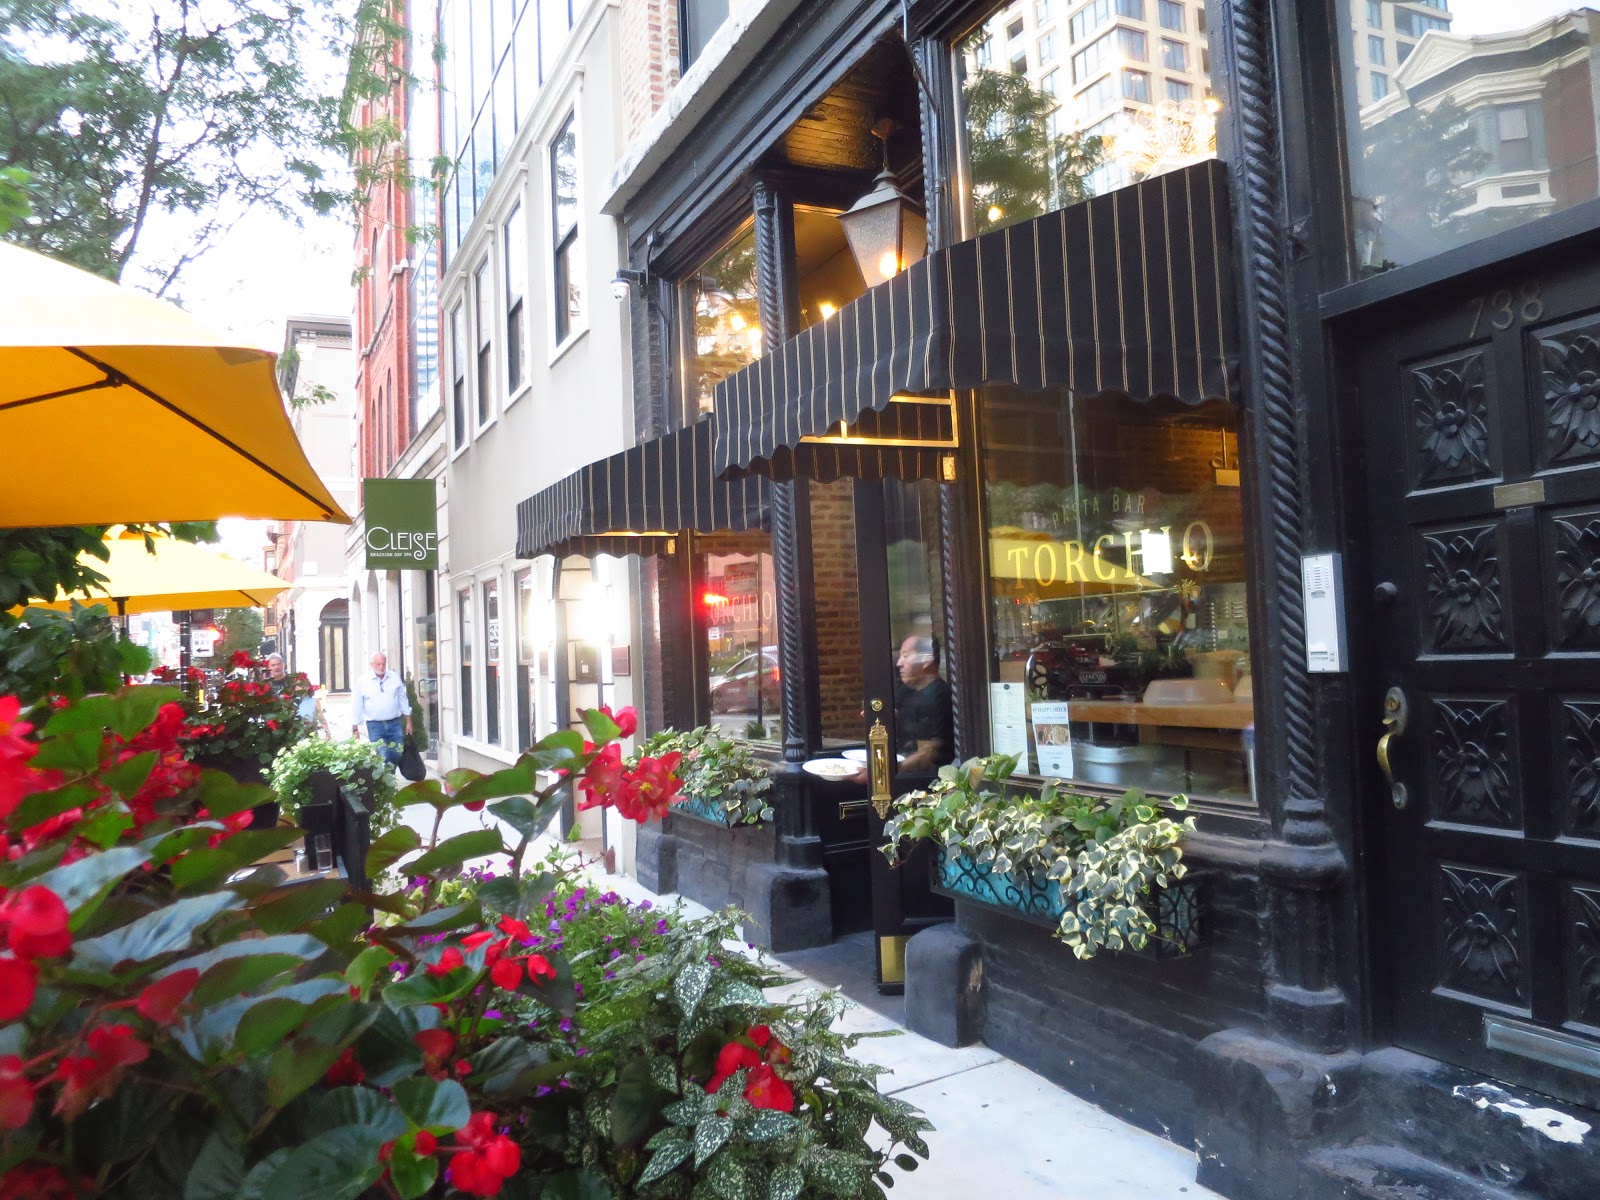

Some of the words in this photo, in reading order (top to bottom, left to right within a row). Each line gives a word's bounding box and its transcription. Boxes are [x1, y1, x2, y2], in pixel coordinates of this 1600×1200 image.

[1468, 281, 1544, 339] 738
[1052, 496, 1100, 529] PASTA
[1112, 493, 1145, 514] BAR
[1007, 520, 1214, 589] TORCHIO
[710, 591, 773, 626] ORCHIO
